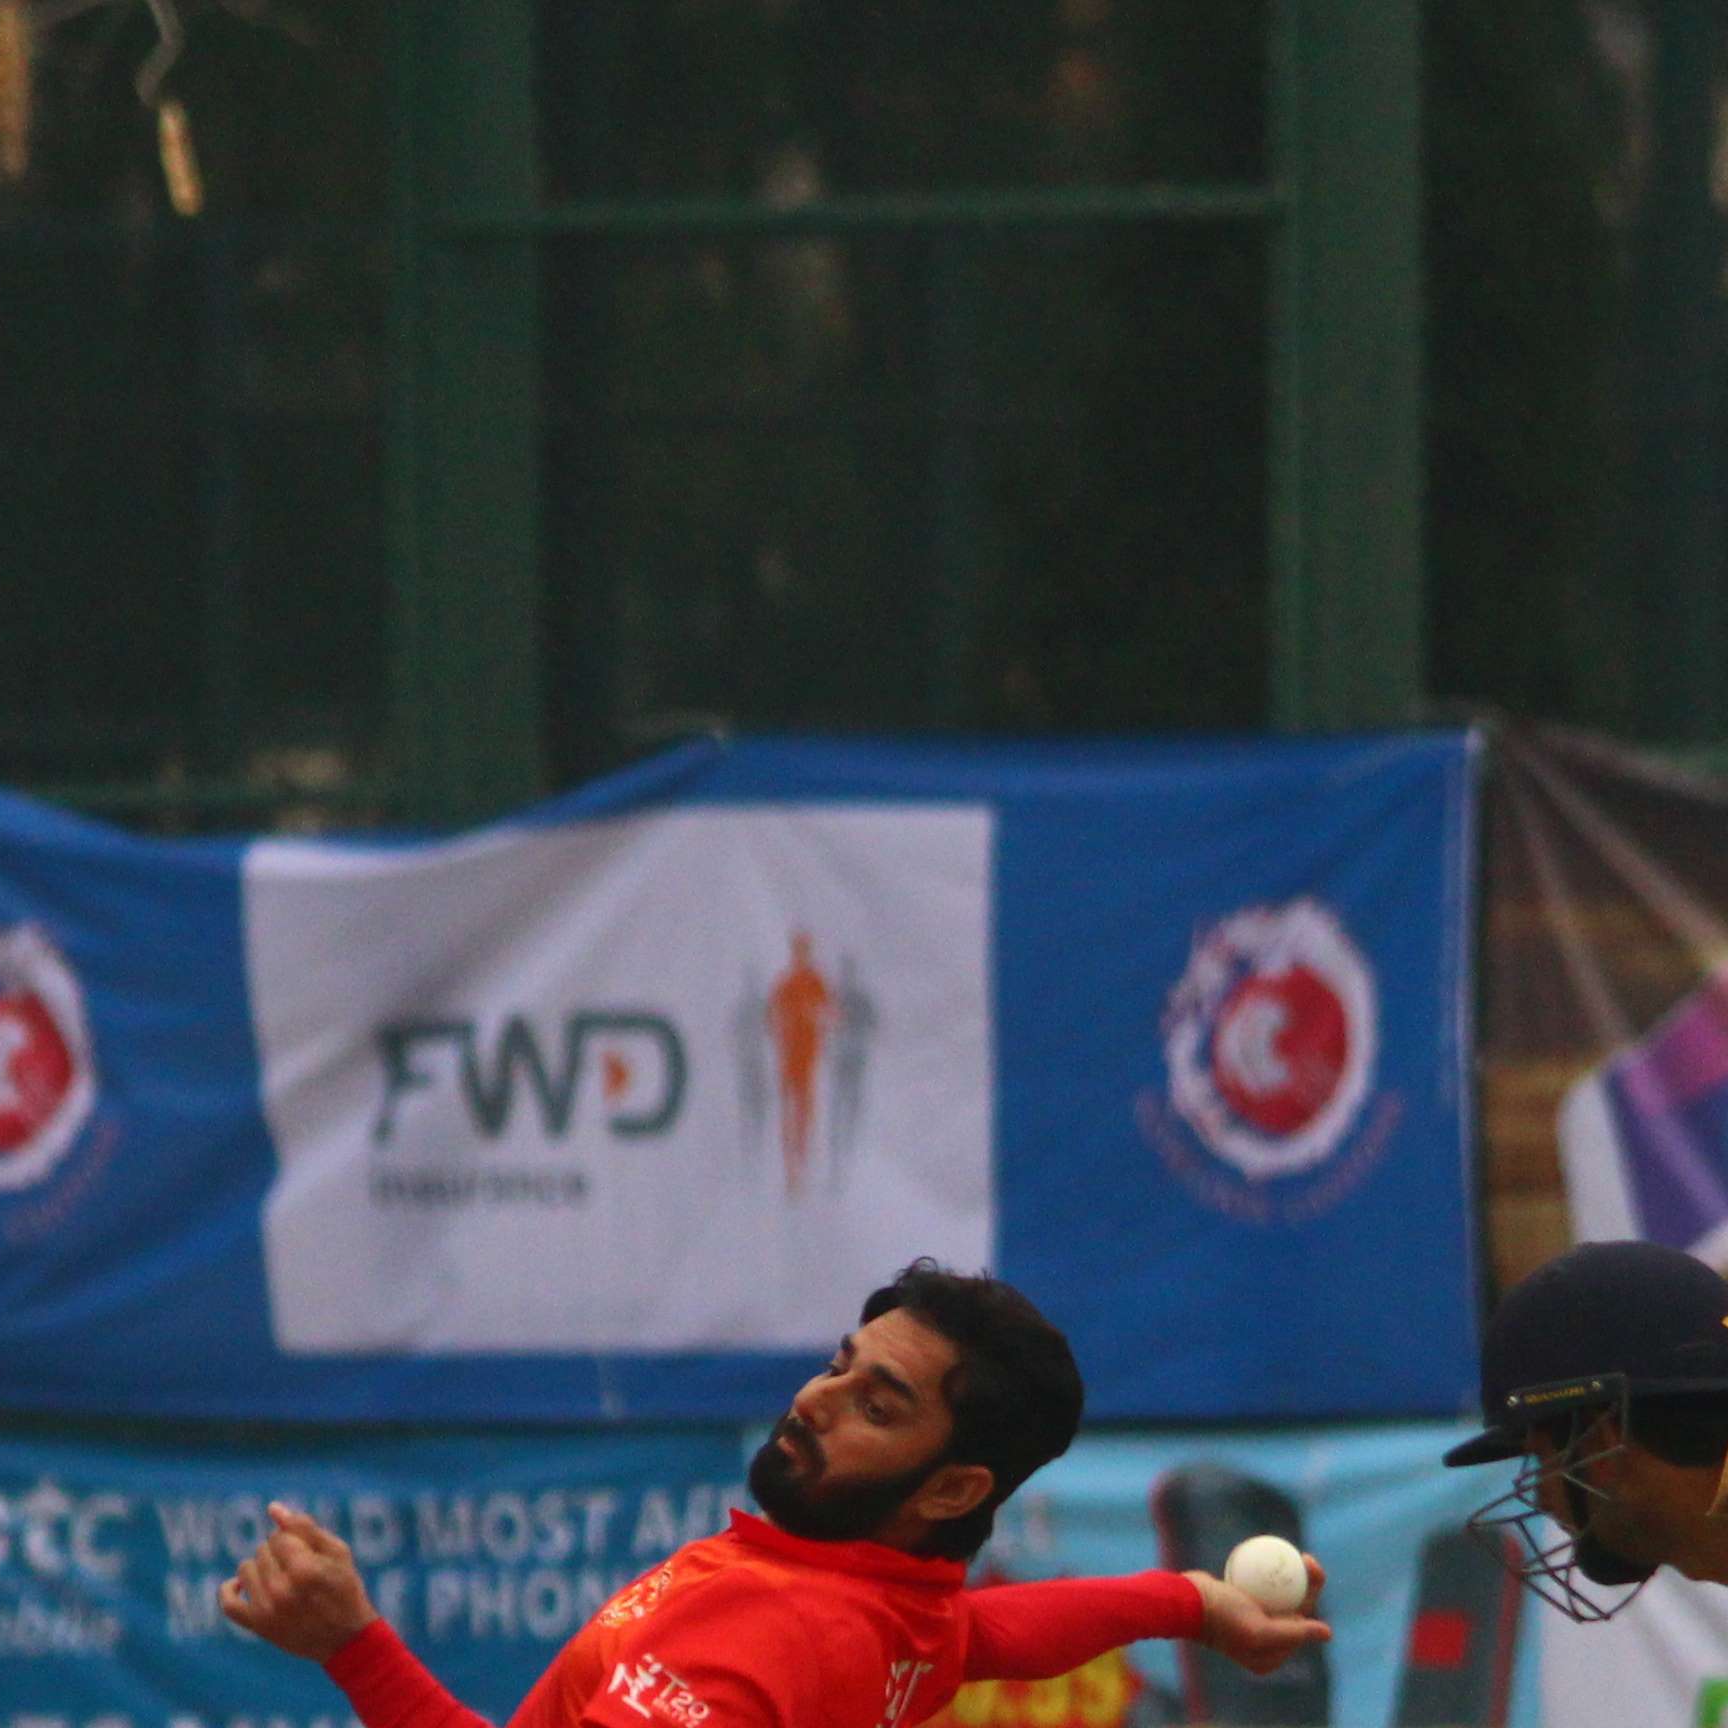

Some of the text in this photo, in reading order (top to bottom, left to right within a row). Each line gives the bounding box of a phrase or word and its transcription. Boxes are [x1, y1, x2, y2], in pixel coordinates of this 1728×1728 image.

[373, 1012, 688, 1143] FWD
[153, 1492, 409, 1564] WOD
[415, 1490, 618, 1562] MOST
